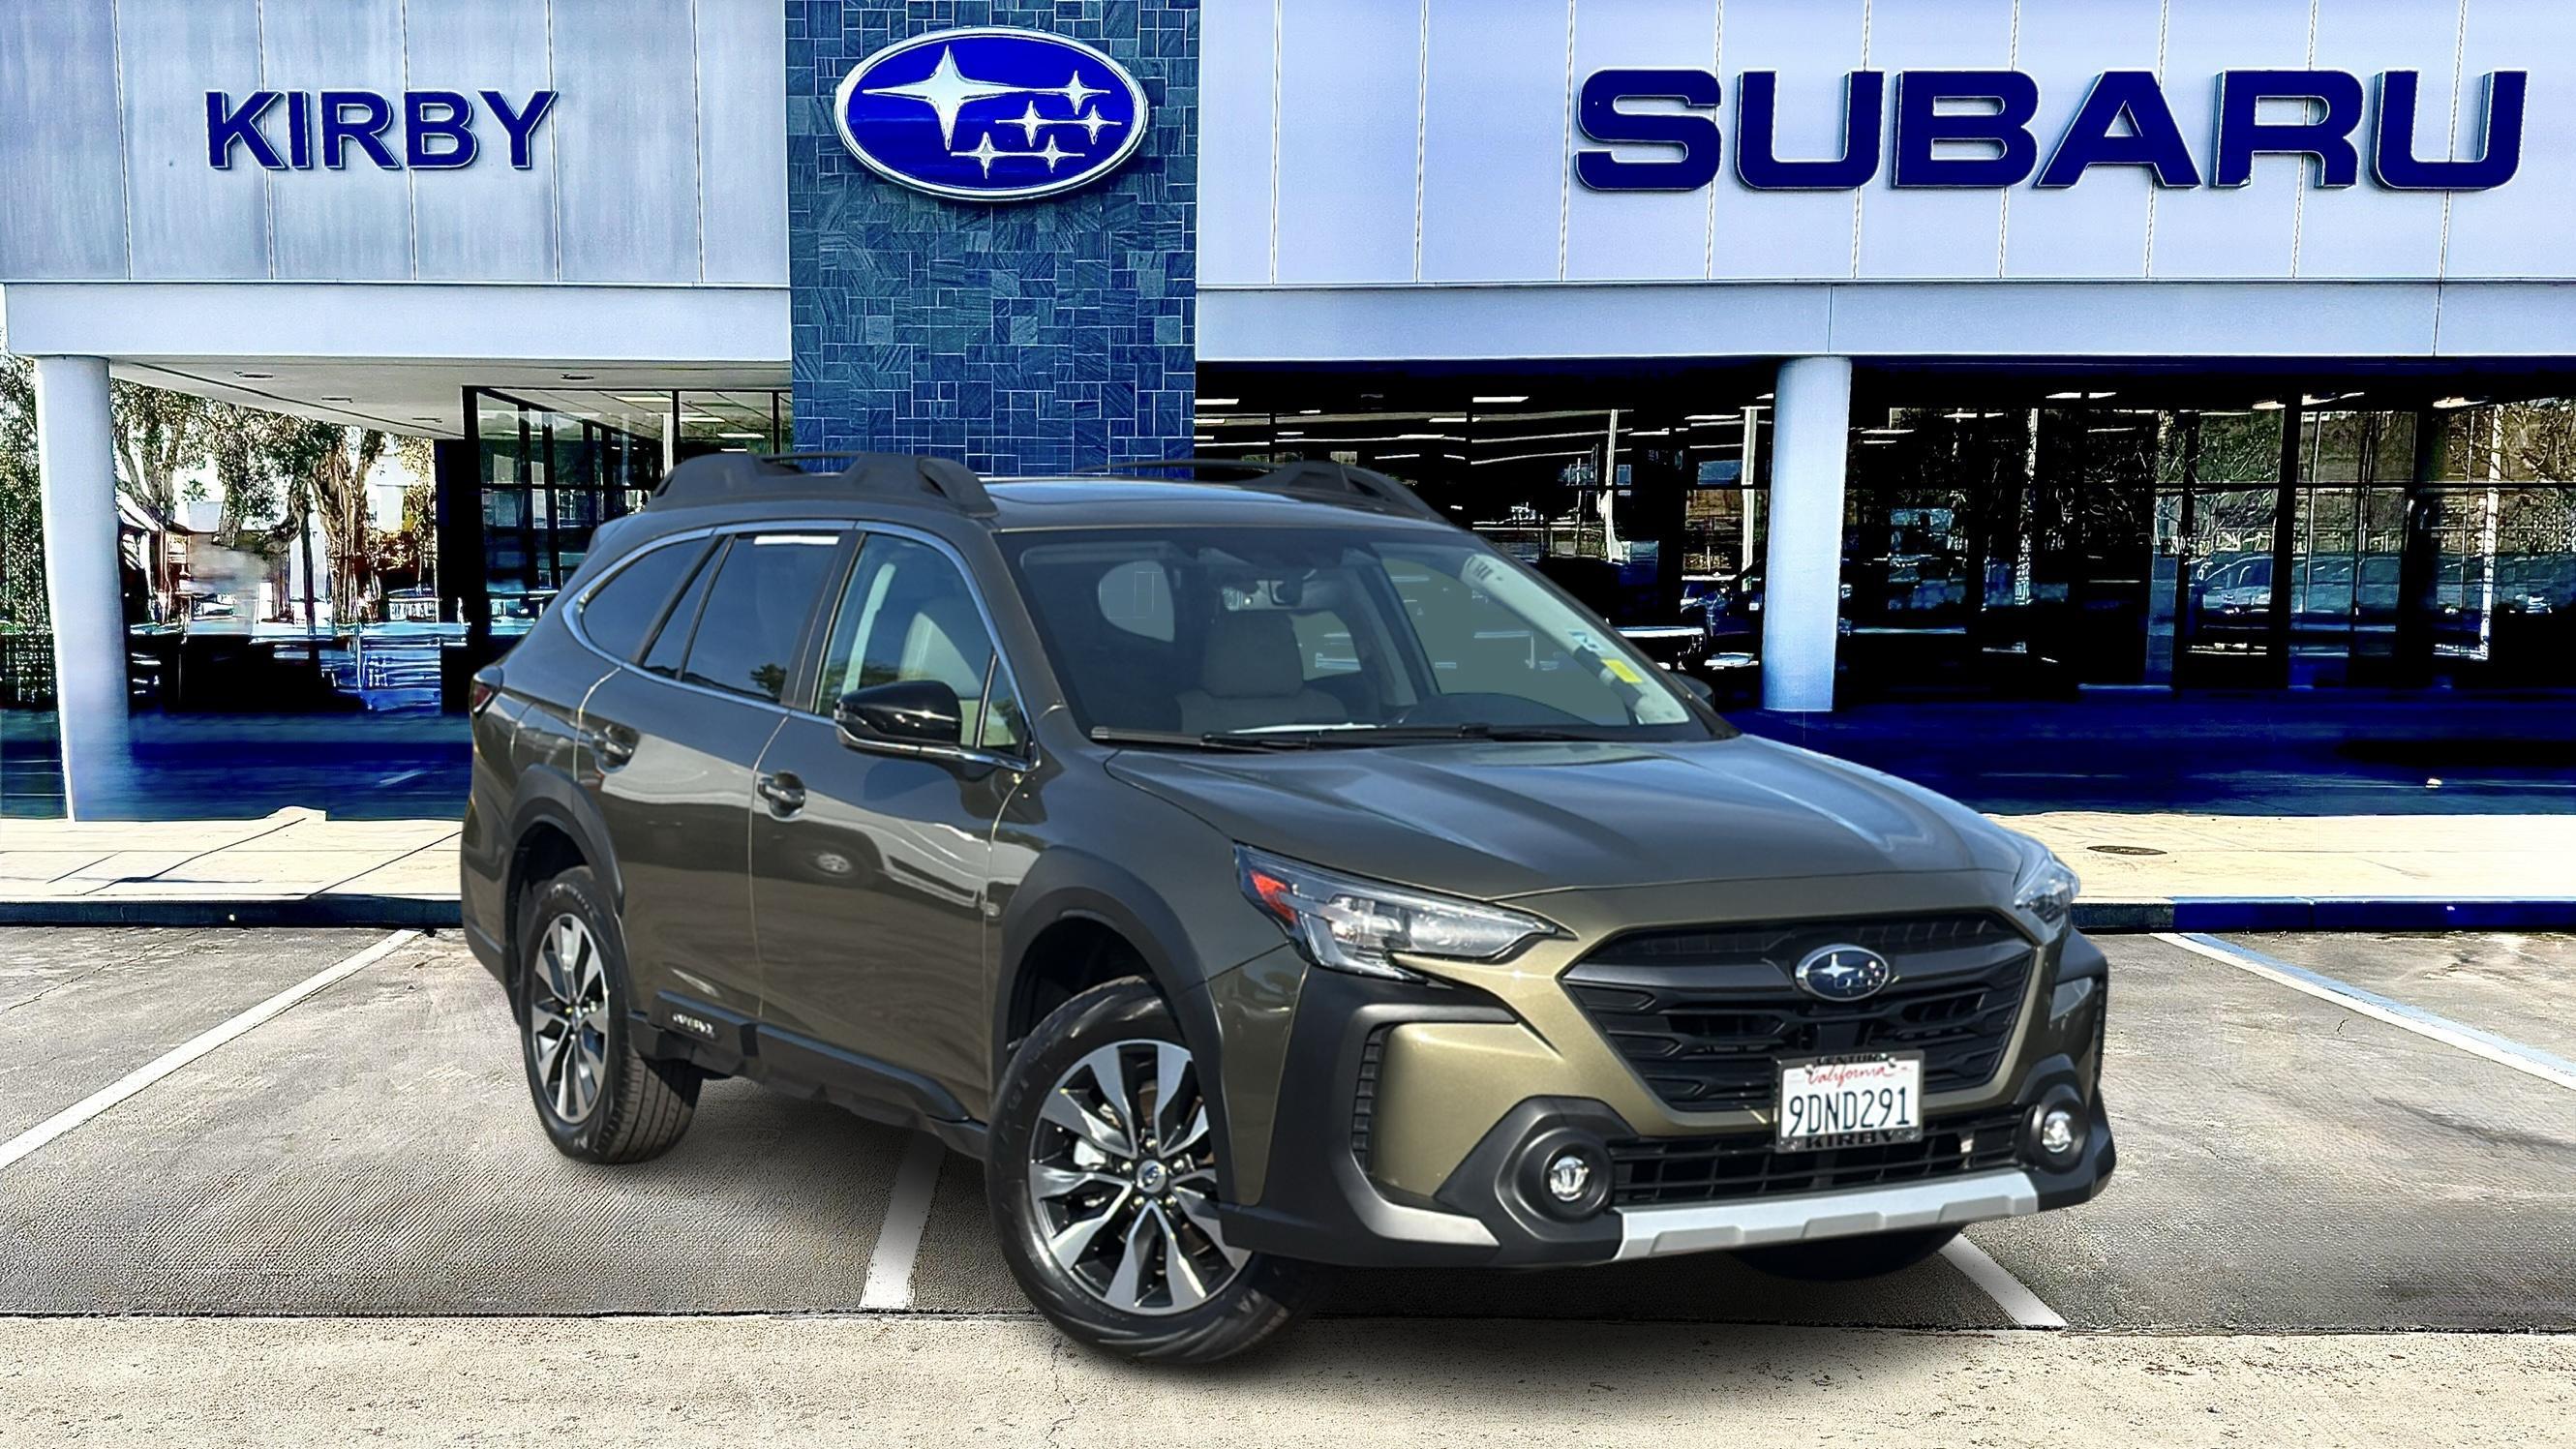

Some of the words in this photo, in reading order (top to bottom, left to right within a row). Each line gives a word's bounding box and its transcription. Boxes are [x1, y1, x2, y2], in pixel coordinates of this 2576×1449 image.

[204, 89, 560, 170] KIRBY
[1575, 68, 2529, 191] SUBARU
[1807, 1066, 1891, 1088] California
[1789, 1085, 1910, 1136] 9DND291
